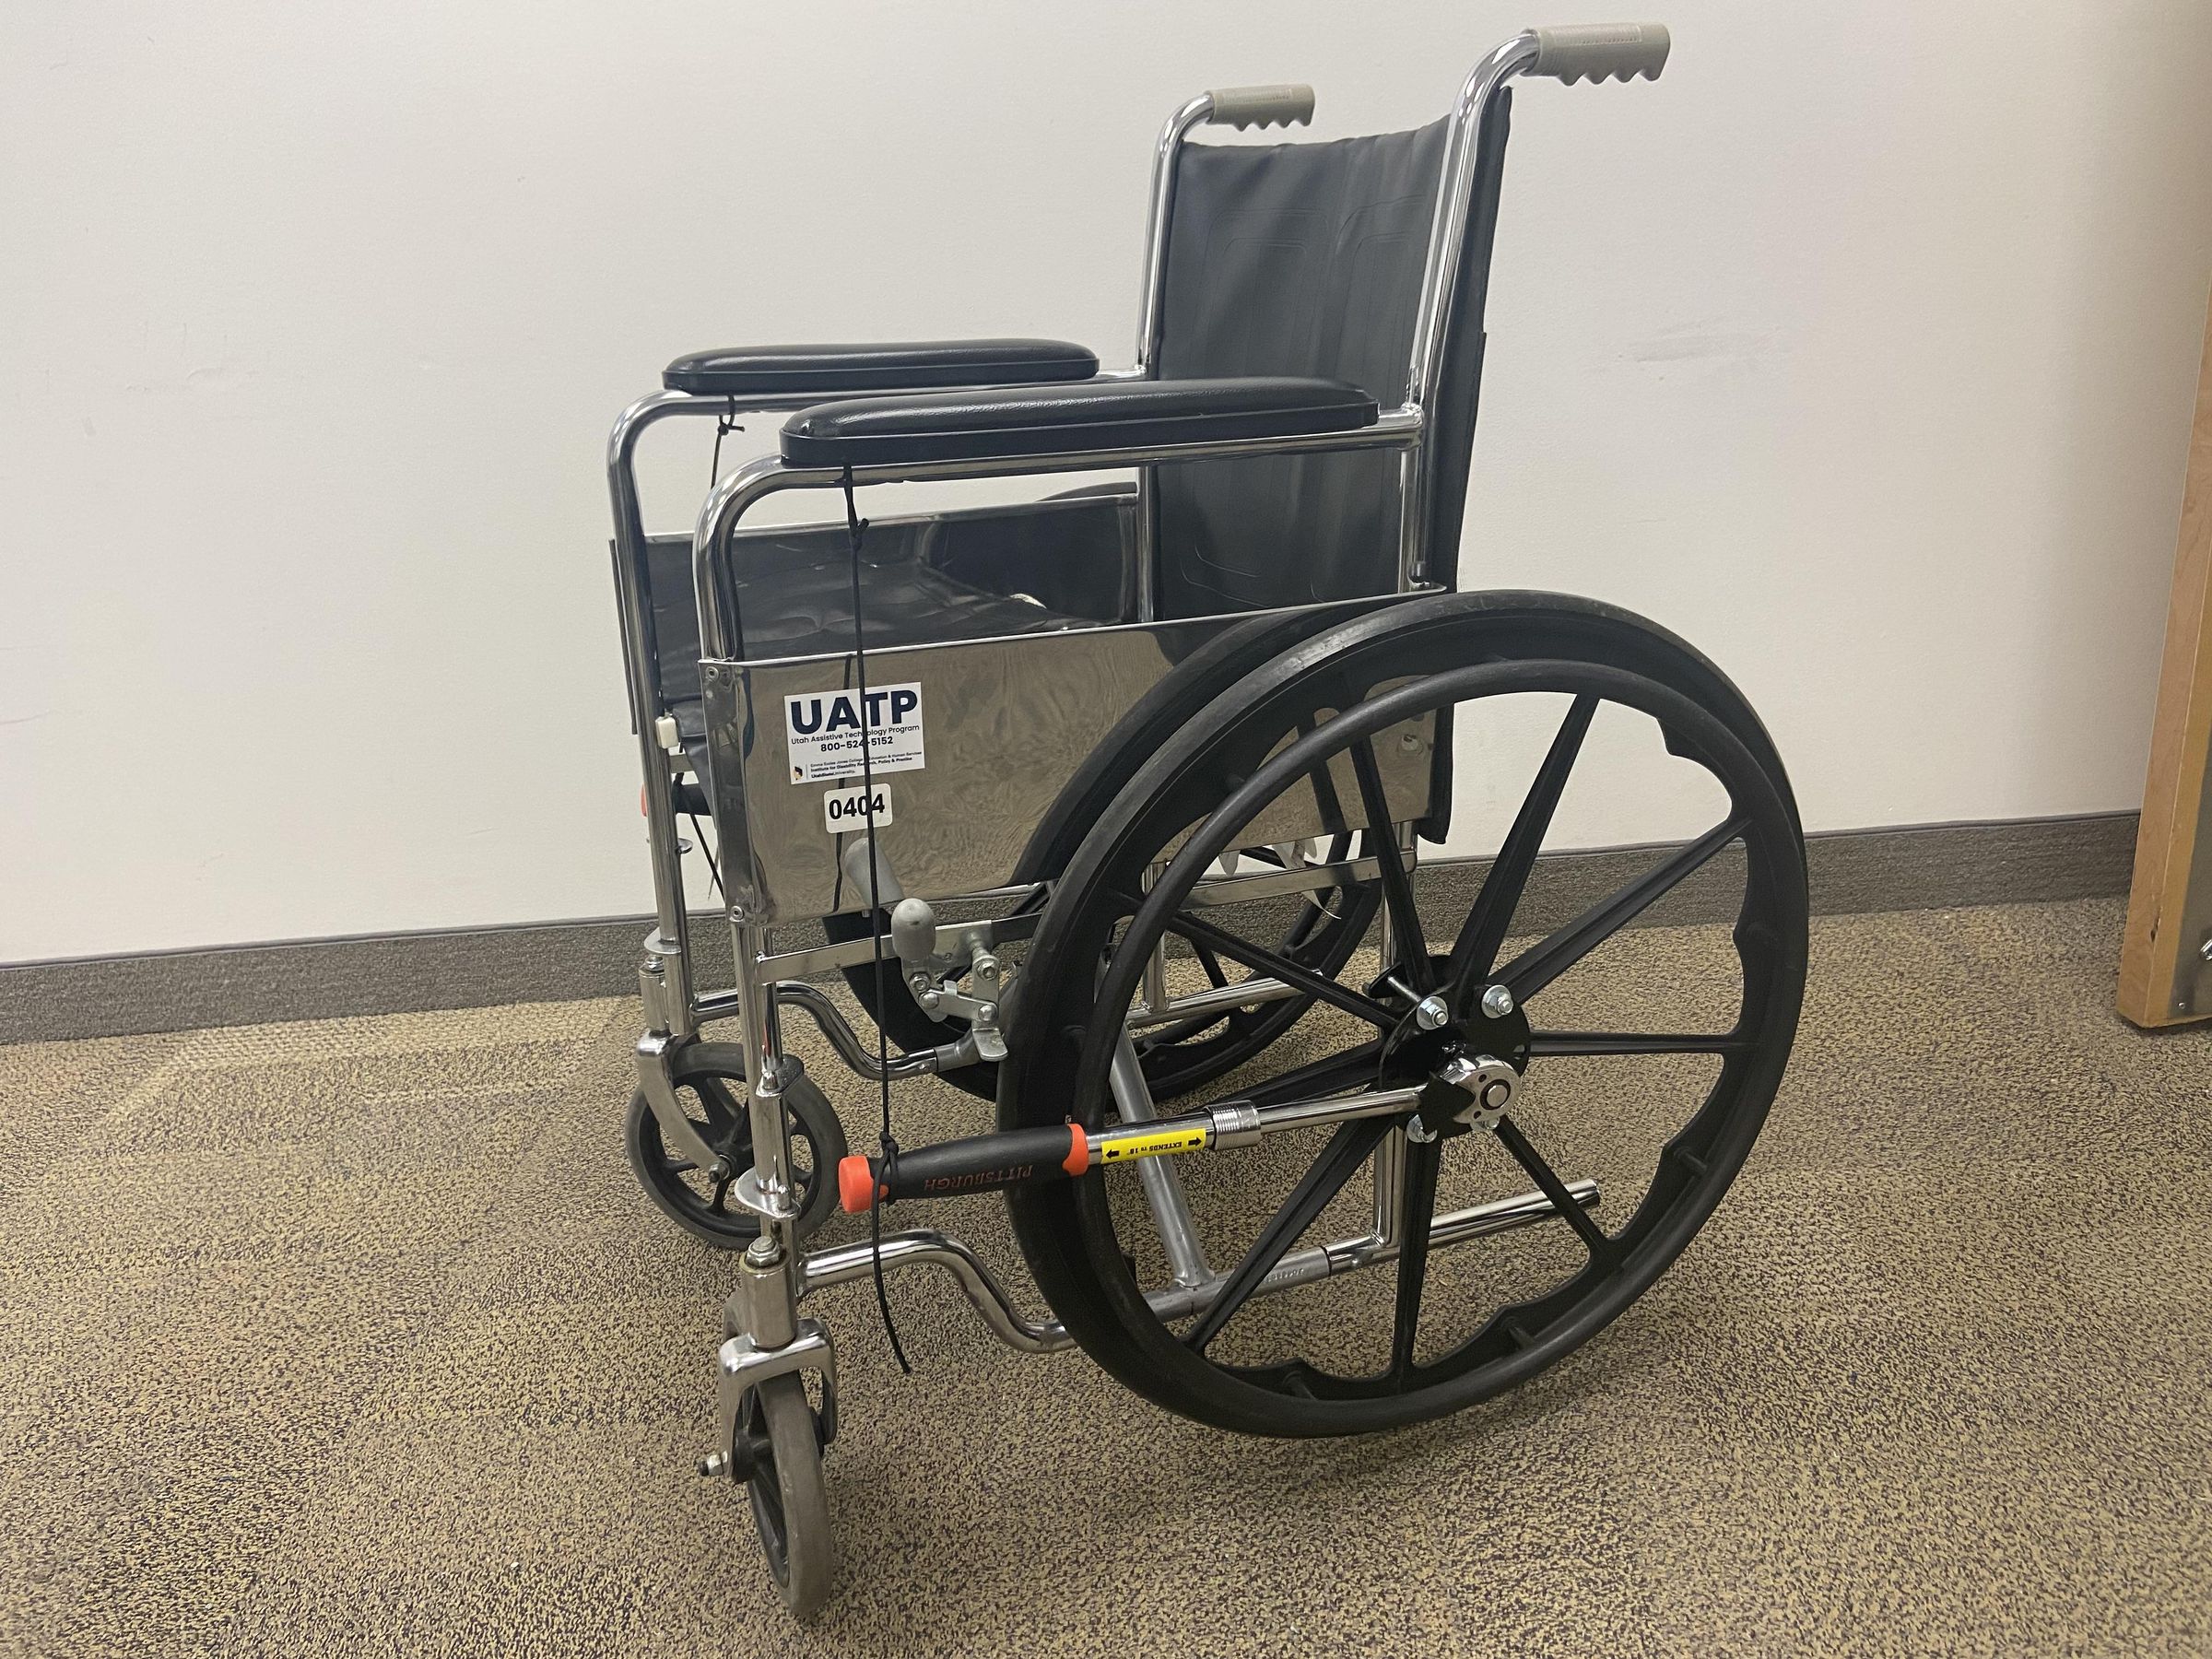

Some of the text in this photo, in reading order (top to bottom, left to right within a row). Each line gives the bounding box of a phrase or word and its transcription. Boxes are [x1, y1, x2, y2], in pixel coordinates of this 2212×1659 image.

[791, 690, 918, 735] UATP
[791, 724, 920, 745] Utah Assistive Techology Program
[829, 793, 886, 819] 0404
[1148, 1141, 1182, 1152] EXTENDS
[924, 1164, 1033, 1191] PITTSBURGH
